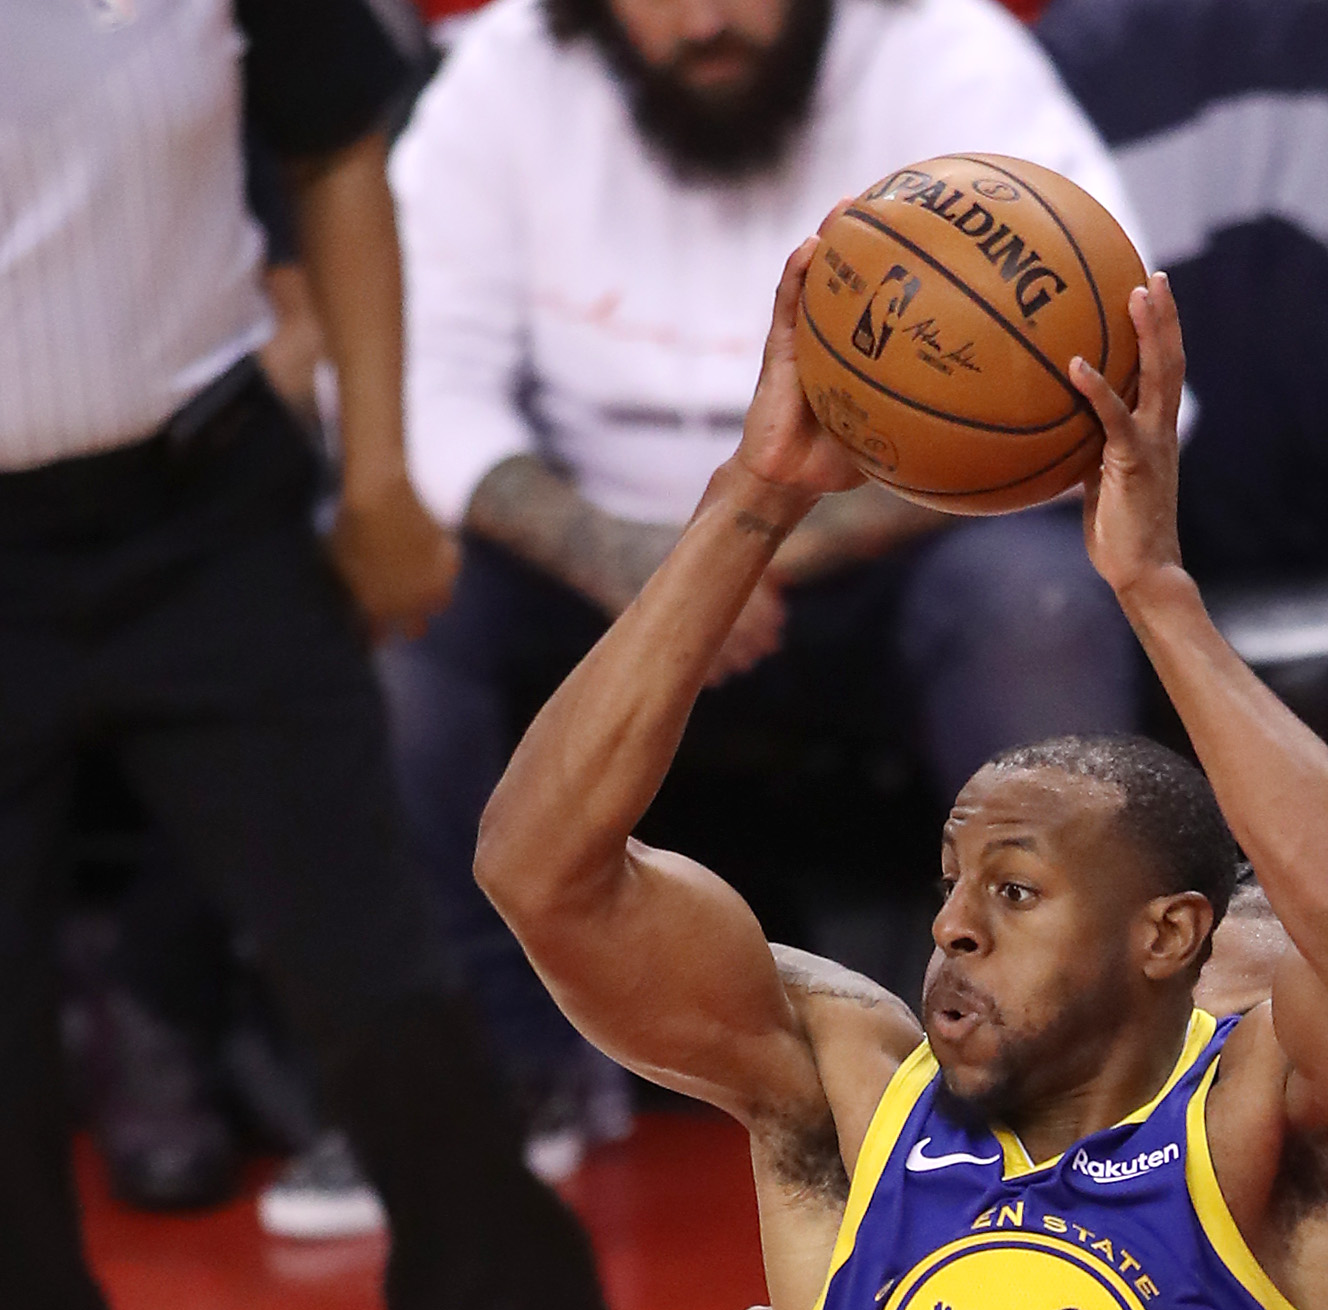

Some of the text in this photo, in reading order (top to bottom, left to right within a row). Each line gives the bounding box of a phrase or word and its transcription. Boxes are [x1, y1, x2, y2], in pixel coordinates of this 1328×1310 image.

[866, 170, 1068, 318] SPALDING
[1072, 1142, 1180, 1180] Rakuten
[1043, 1215, 1160, 1300] STATE
